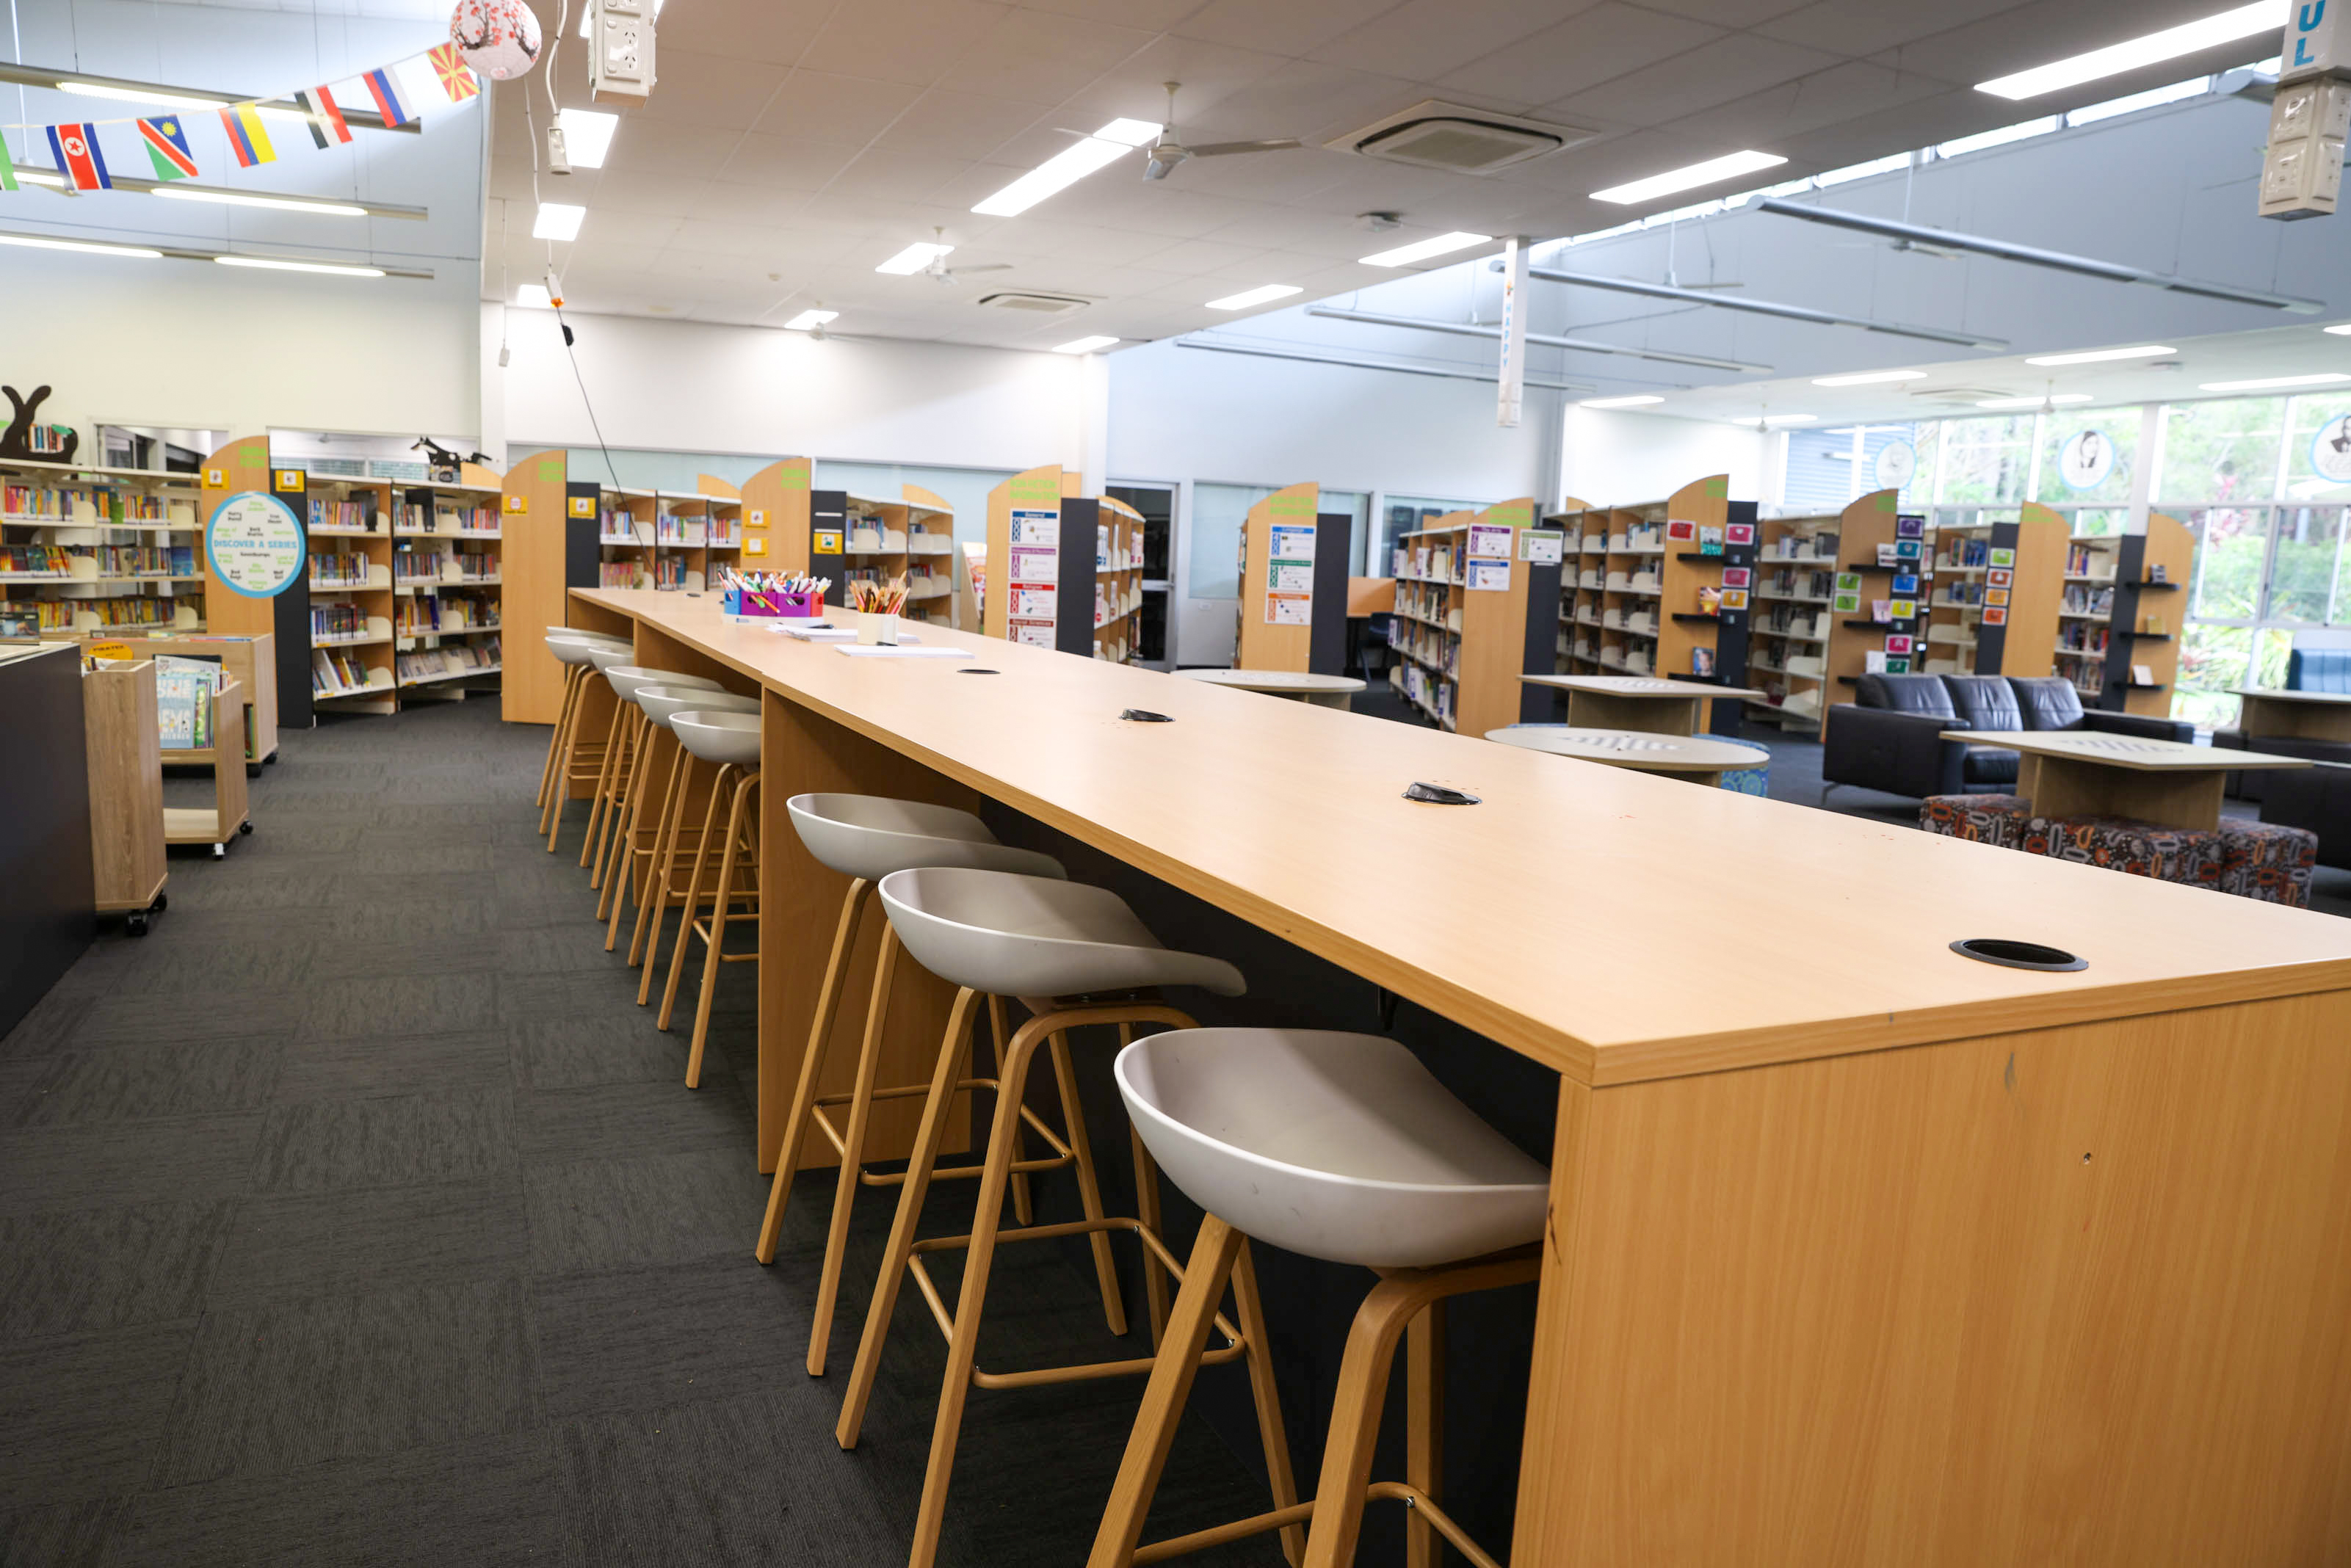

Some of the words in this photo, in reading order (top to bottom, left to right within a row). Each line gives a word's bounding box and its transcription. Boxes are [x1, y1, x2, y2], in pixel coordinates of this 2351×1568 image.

[268, 540, 297, 548] SERIES
[157, 687, 192, 698] OME
[158, 709, 191, 733] EMS
